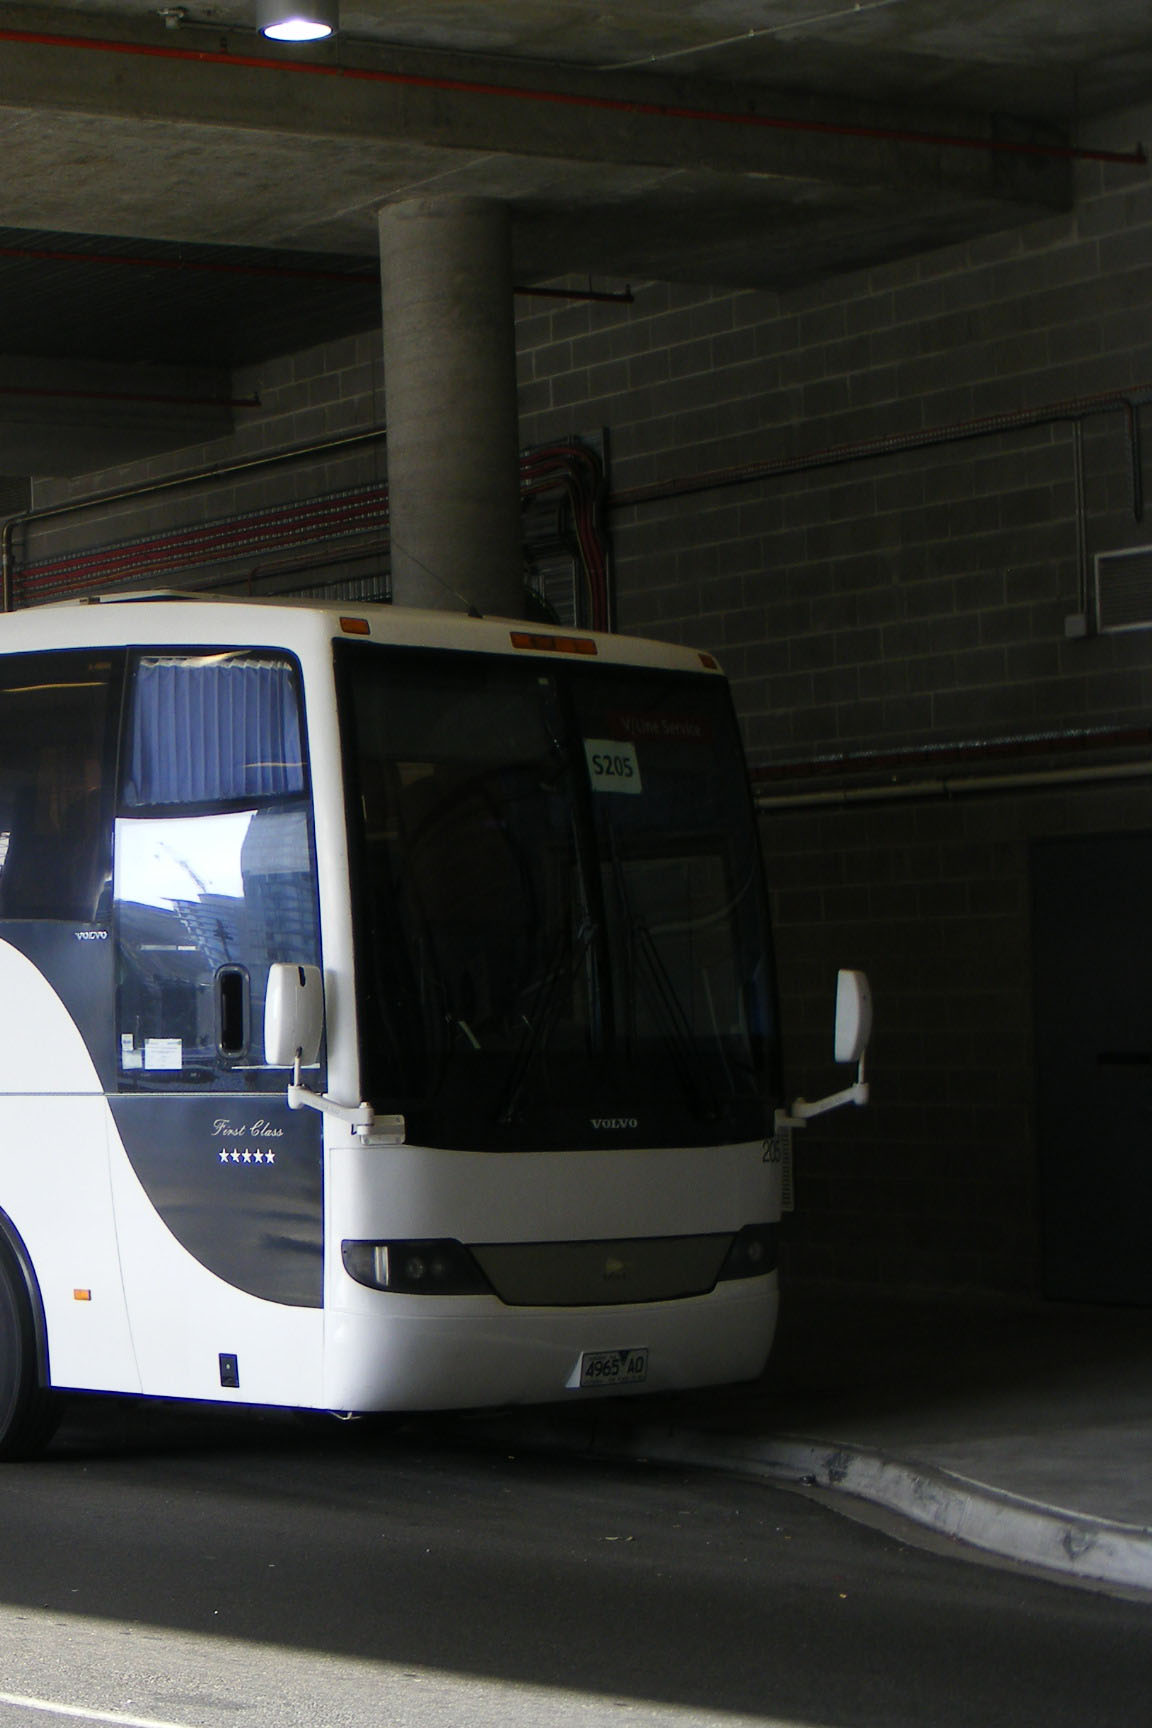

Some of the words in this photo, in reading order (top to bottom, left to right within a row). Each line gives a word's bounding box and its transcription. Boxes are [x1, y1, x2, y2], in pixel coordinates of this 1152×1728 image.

[592, 755, 633, 777] S205
[74, 930, 108, 941] VOLVO
[211, 1119, 247, 1136] First
[249, 1119, 284, 1137] Class
[590, 1118, 638, 1129] VOLVO
[585, 1360, 620, 1377] 4965
